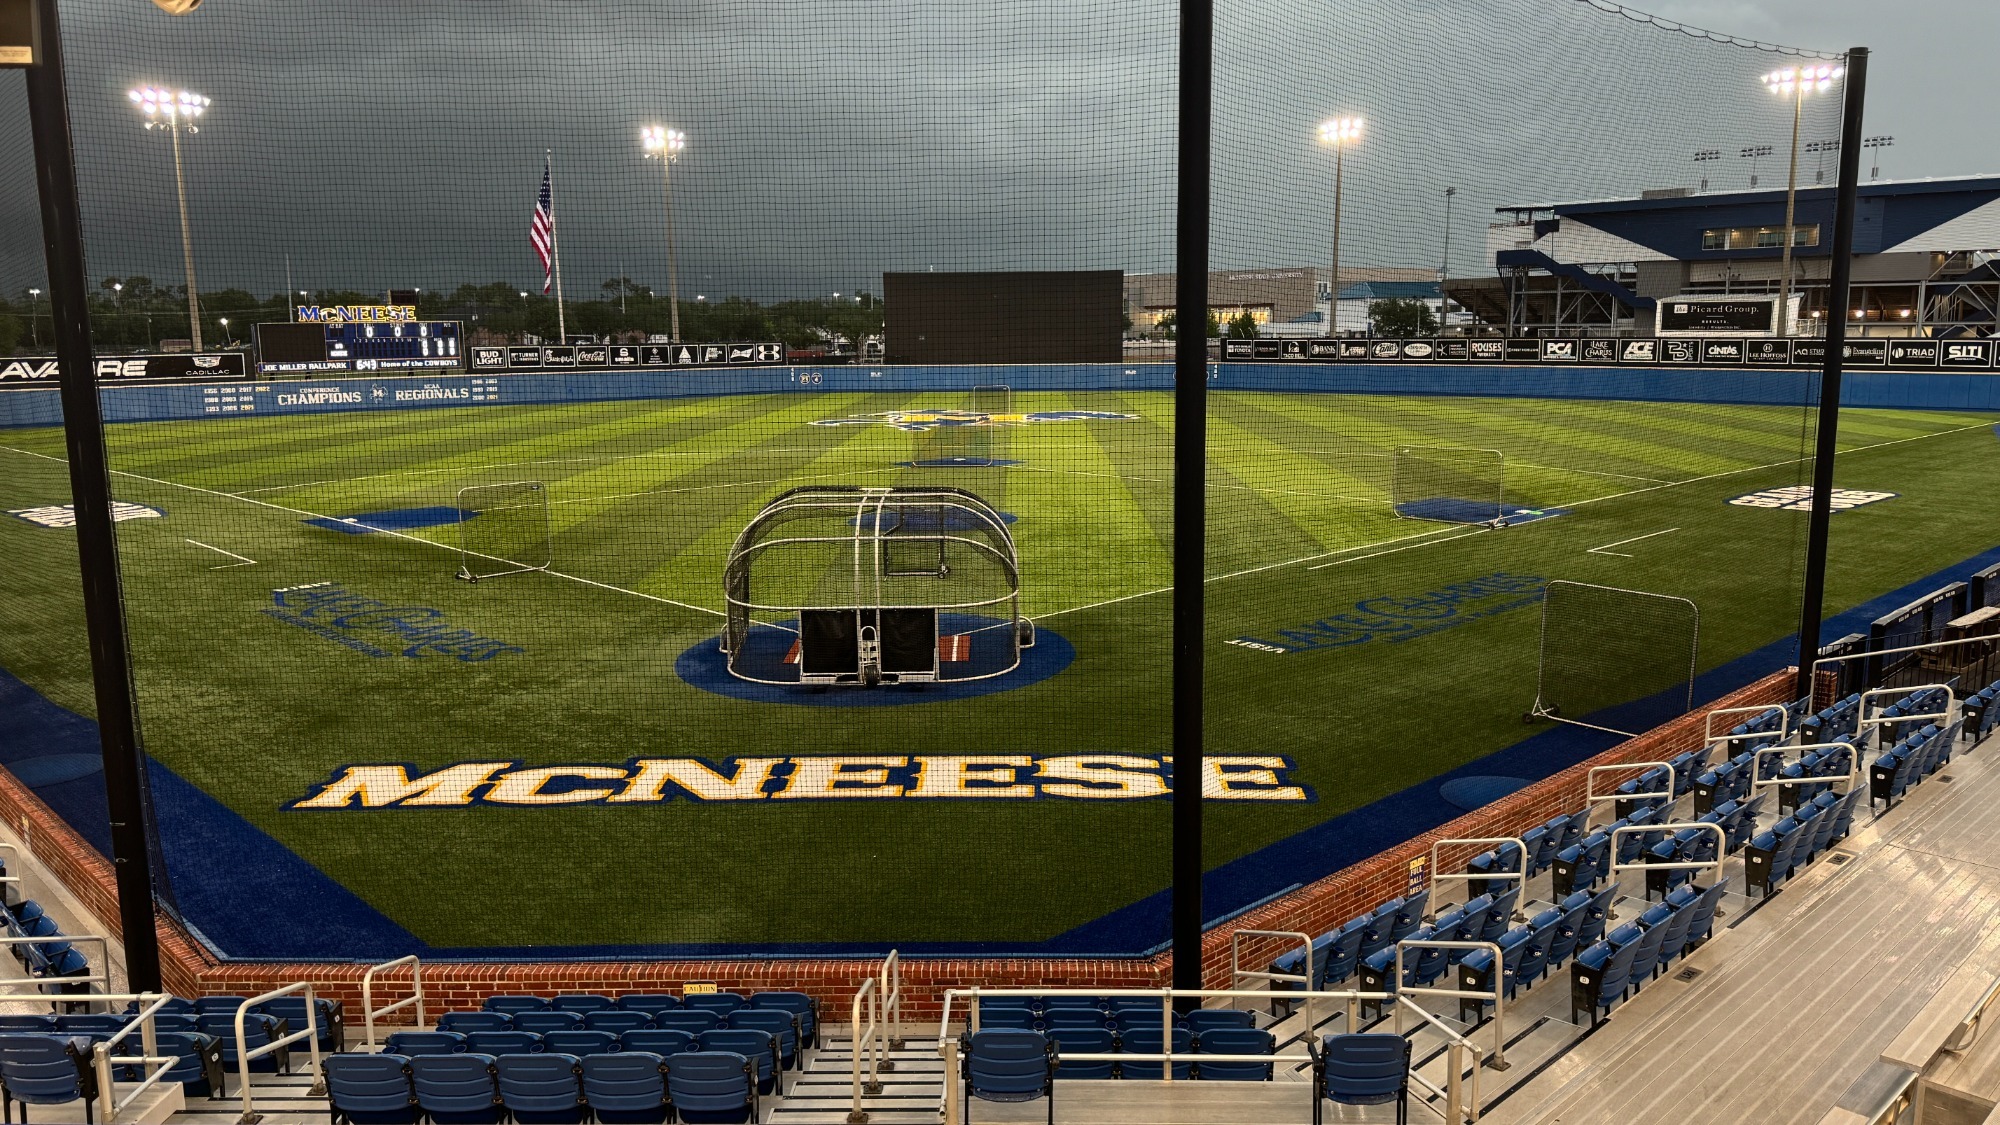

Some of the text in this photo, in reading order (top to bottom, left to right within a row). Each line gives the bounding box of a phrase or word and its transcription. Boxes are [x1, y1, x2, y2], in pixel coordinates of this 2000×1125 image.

[1690, 305, 1723, 313] Picard
[1471, 342, 1502, 353] ROUSES
[1547, 342, 1572, 355] PCA
[1592, 341, 1608, 349] LAKE
[1625, 342, 1654, 354] ACE
[1585, 348, 1612, 358] CHARLES
[476, 357, 503, 365] LIGHT
[279, 363, 306, 371] MILLER
[309, 362, 347, 370] BALLPARK
[277, 391, 362, 406] CHAMPIONS
[395, 388, 469, 401] REGIONALS
